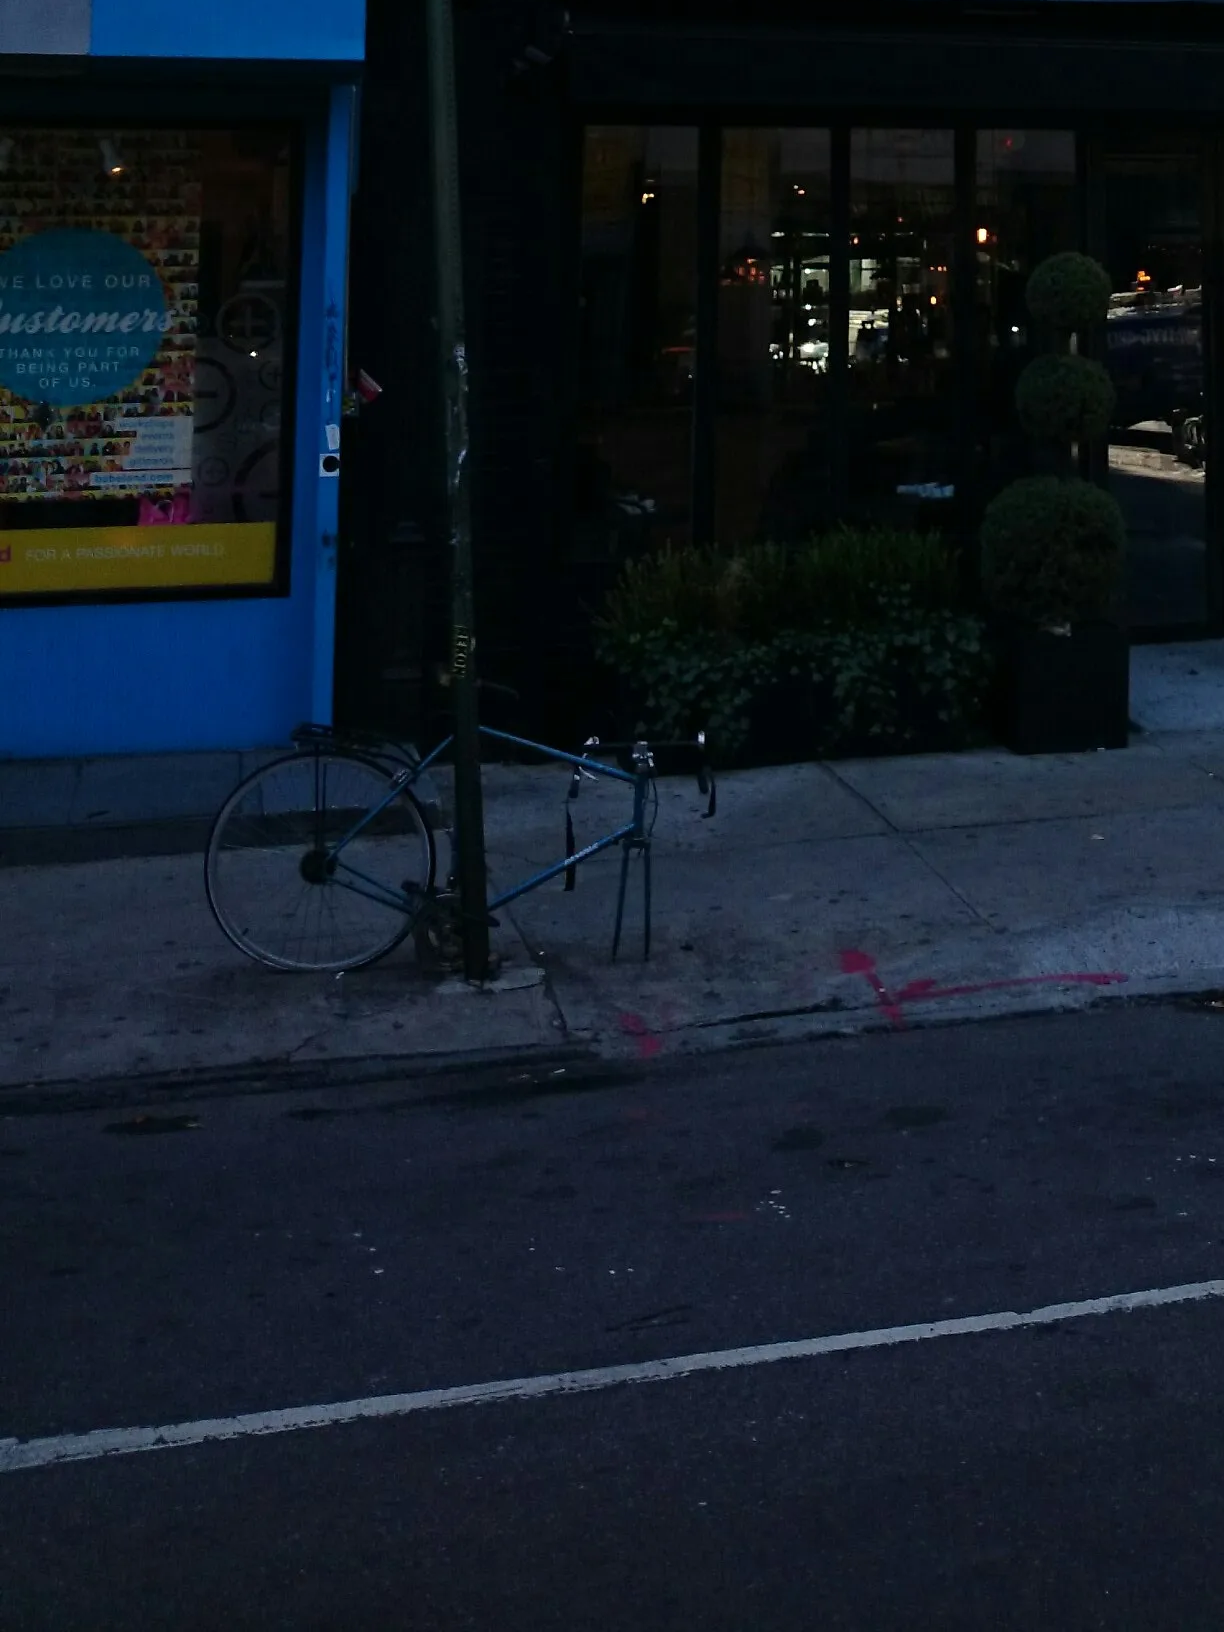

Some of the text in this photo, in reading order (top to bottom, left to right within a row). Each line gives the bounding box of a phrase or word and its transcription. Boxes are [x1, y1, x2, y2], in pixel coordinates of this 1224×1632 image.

[36, 274, 93, 289] LOVE
[105, 274, 151, 289] OUR
[0, 299, 176, 334] ustomers
[64, 347, 98, 358] YOU
[107, 346, 140, 357] FOR
[16, 361, 120, 374] BEING PART
[39, 377, 61, 389] OF
[25, 547, 57, 561] FOR
[61, 547, 72, 561] A
[76, 543, 166, 559] PASSIONATE
